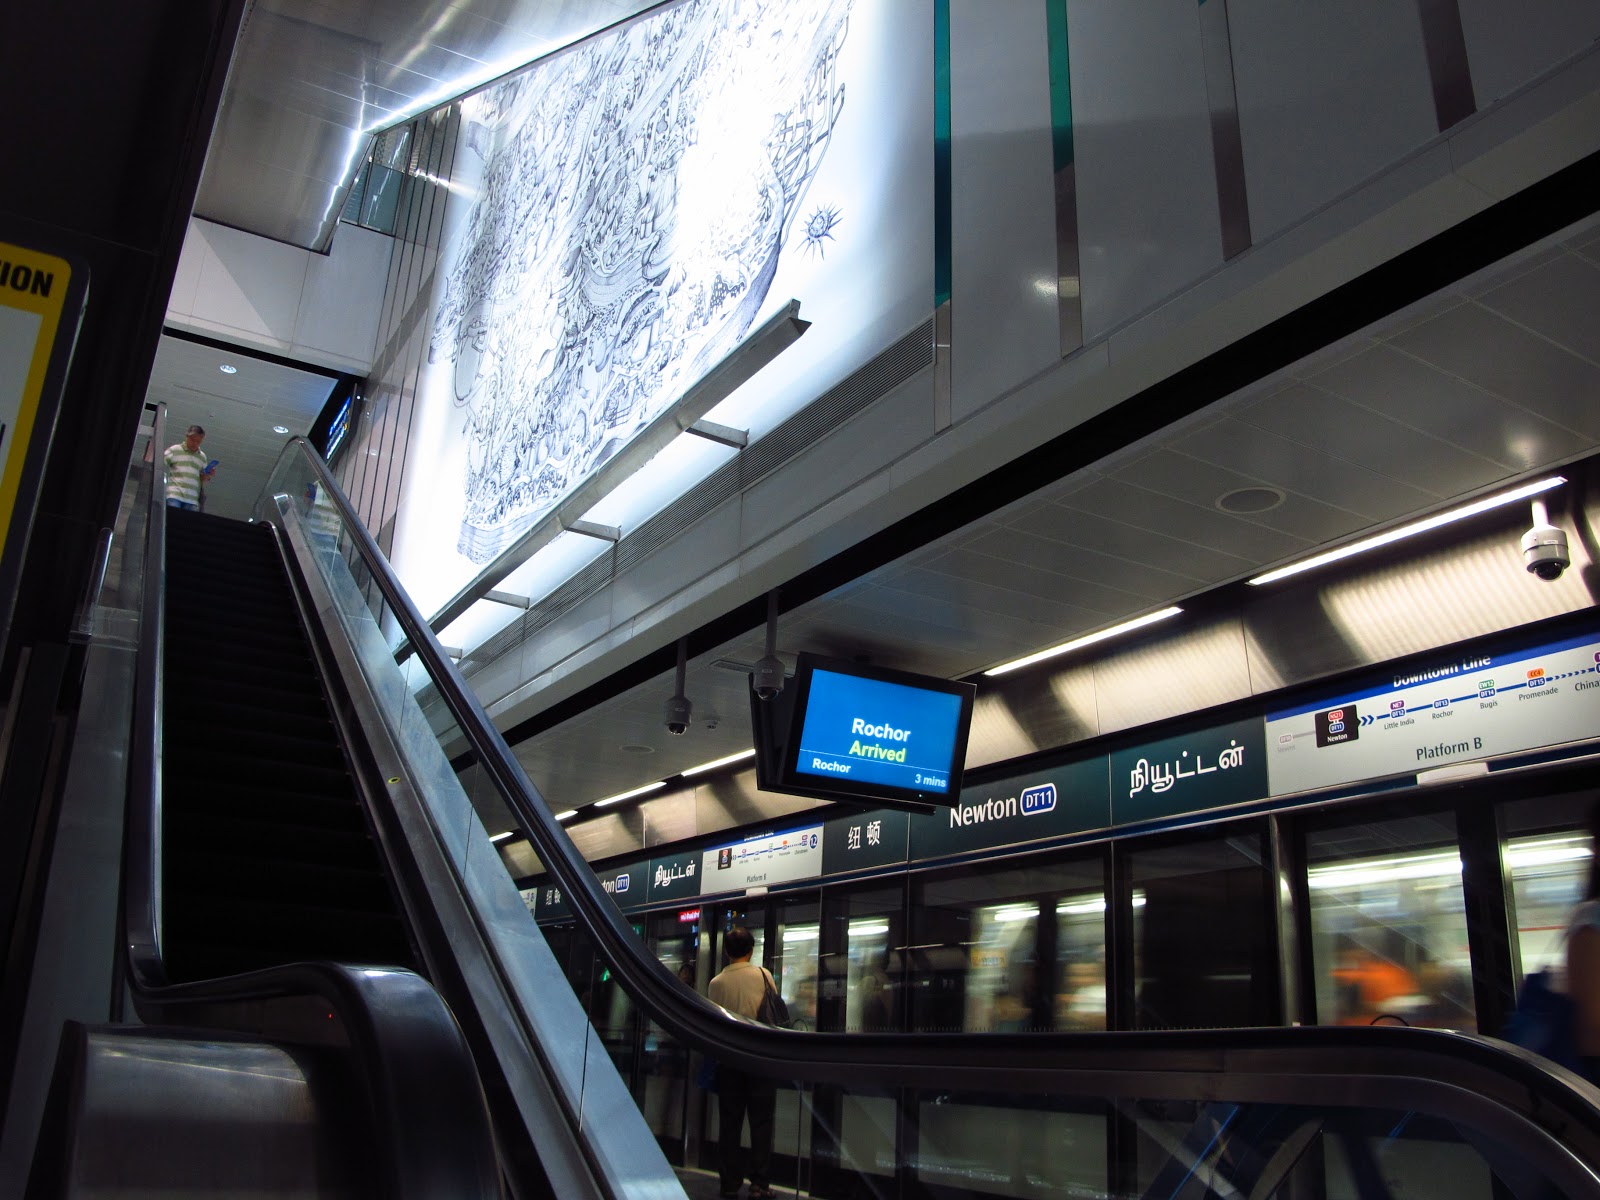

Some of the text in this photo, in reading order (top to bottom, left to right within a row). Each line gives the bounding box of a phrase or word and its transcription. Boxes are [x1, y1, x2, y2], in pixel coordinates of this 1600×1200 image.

[0, 259, 54, 298] ION
[1393, 655, 1491, 687] Downtown Line
[1530, 669, 1541, 677] CC4
[1479, 679, 1495, 688] EW12
[1529, 678, 1544, 687] DT15
[1574, 680, 1600, 691] China
[1480, 689, 1495, 698] DT14
[1518, 687, 1559, 701] Promenade
[1434, 699, 1449, 709] DT13
[1479, 700, 1498, 710] Bugis
[1432, 709, 1454, 720] Rochor
[851, 717, 911, 742] Rochor
[1384, 718, 1415, 731] Little India
[1327, 733, 1348, 743] Newton
[848, 739, 906, 763] Arrived
[1416, 737, 1483, 760] Platform B
[812, 758, 947, 788] Rochor 3 mins
[1129, 739, 1245, 799] நியூட்டன்
[949, 790, 1052, 828] Newton DT11
[847, 820, 882, 850] 纽顿
[602, 879, 615, 894] ton
